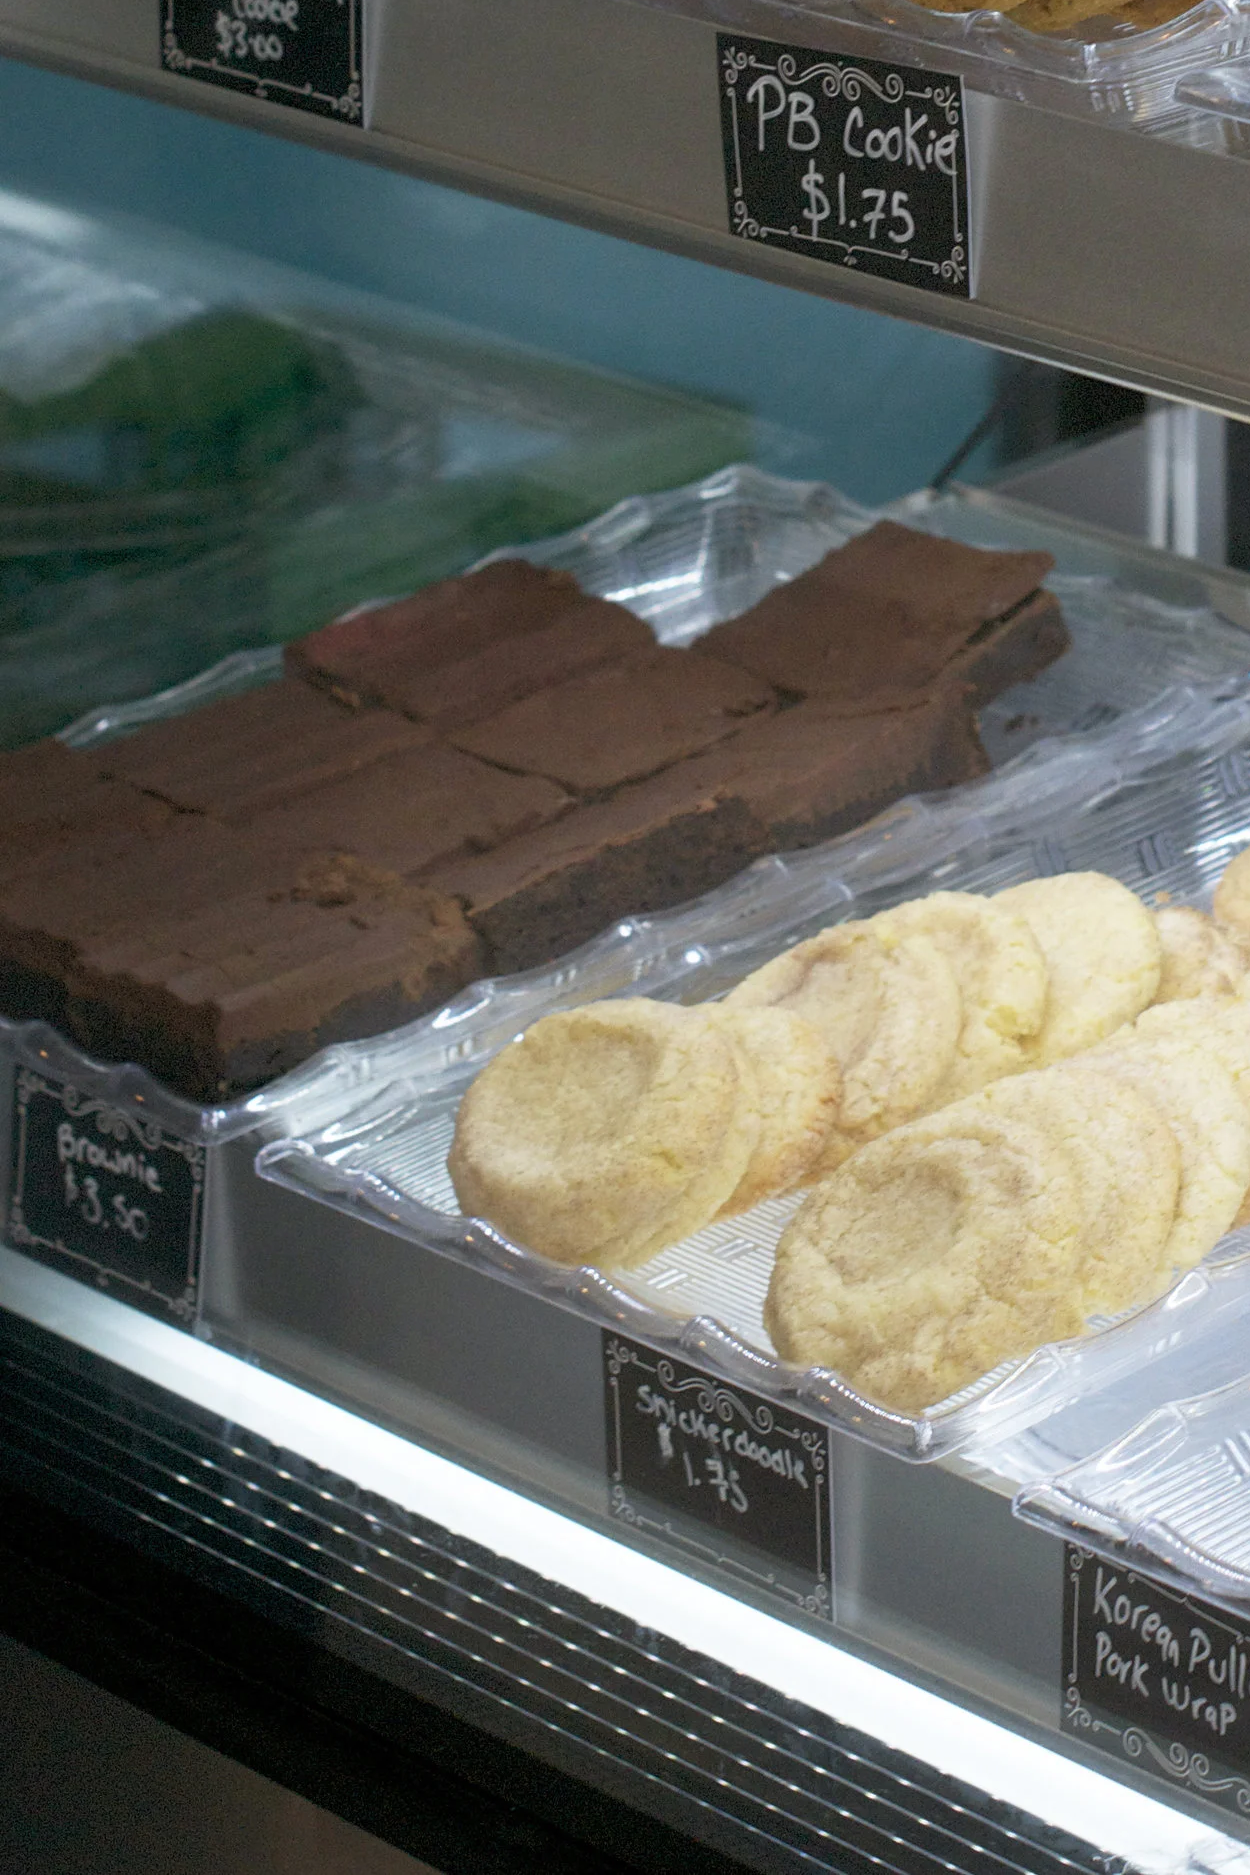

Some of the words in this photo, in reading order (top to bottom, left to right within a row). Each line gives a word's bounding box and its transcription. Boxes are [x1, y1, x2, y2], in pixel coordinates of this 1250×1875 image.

[746, 74, 821, 152] PB
[843, 106, 959, 176] Cookie
[801, 158, 915, 243] $1.75
[636, 1385, 809, 1490] Snickerdoodle
[1093, 1566, 1180, 1668] Korean
[1095, 1631, 1150, 1697] Pork
